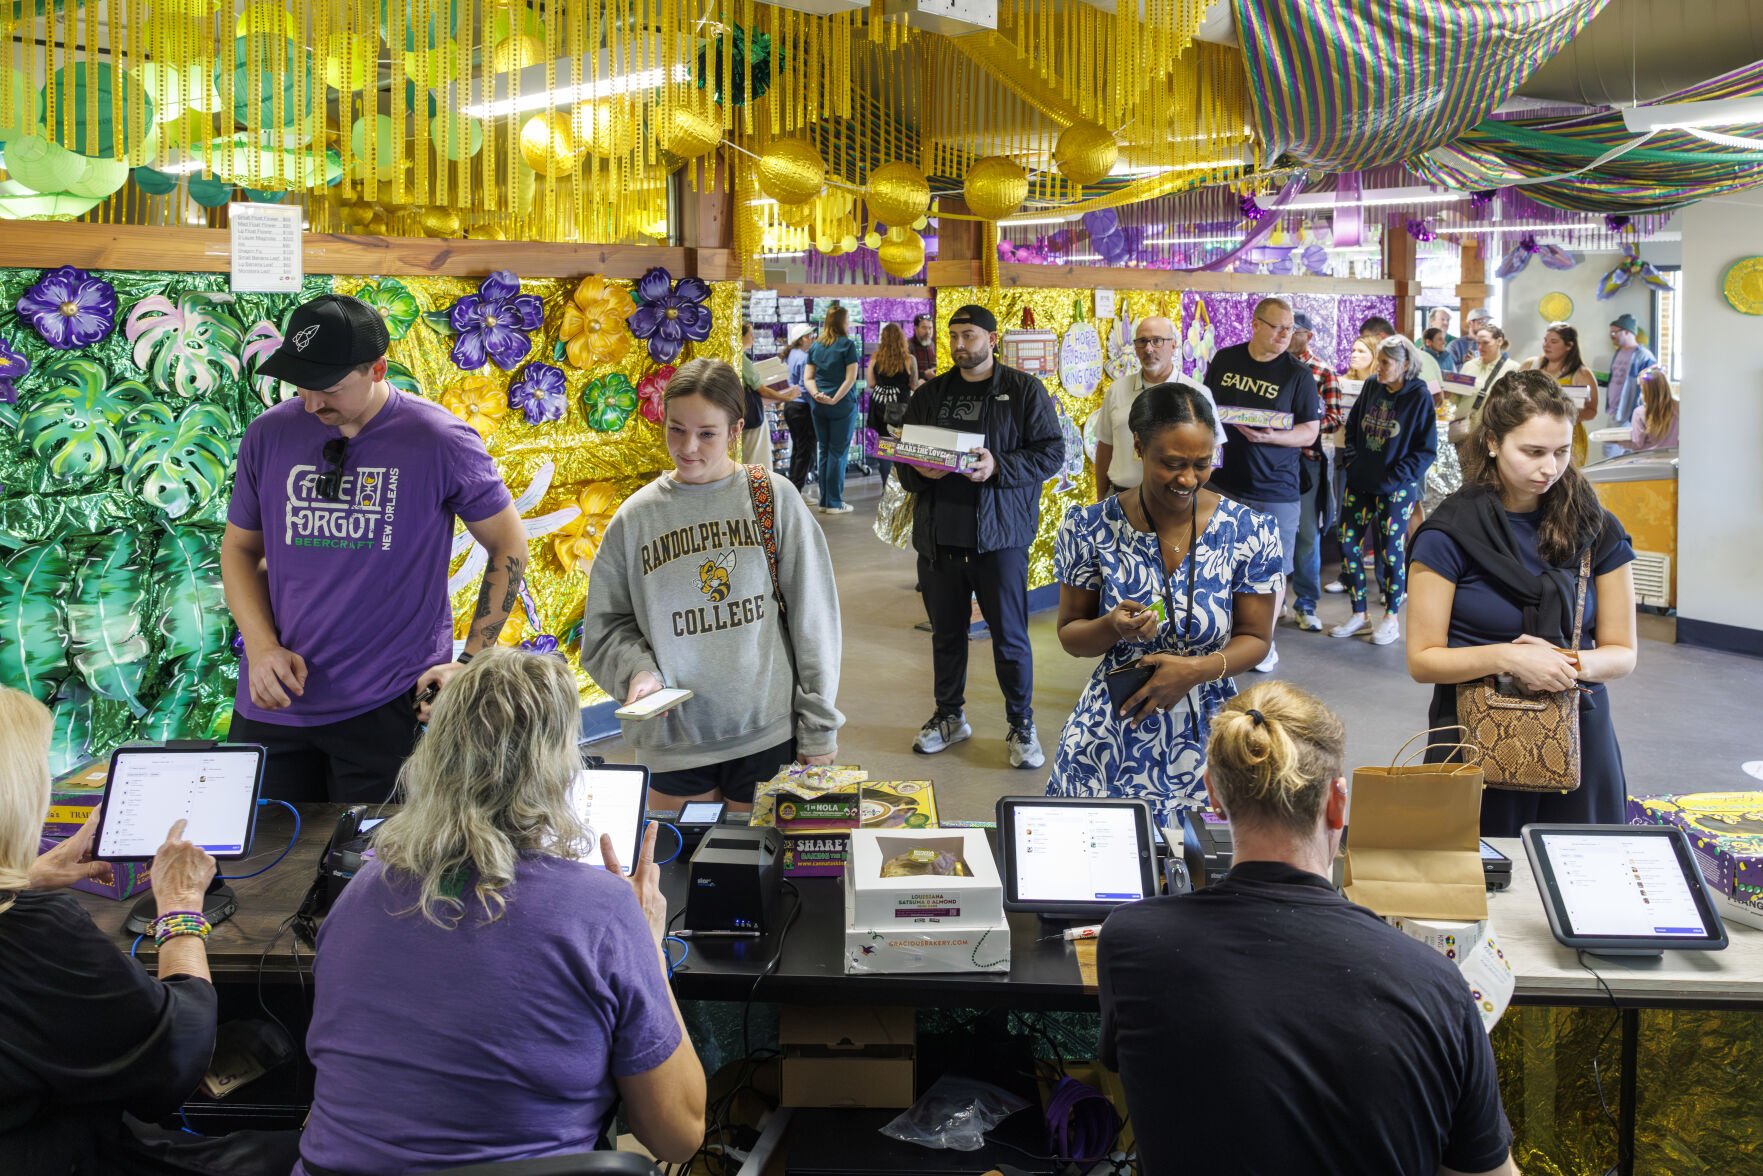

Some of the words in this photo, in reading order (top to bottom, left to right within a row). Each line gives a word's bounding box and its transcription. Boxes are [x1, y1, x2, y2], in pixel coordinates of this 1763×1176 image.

[1066, 334, 1072, 348] I
[1075, 330, 1097, 346] HOPE
[1074, 349, 1100, 365] BROUGHT
[1065, 370, 1083, 386] KING
[1084, 366, 1101, 384] CAKE
[1221, 372, 1280, 399] SAINTS
[286, 464, 354, 508] CAE
[385, 468, 399, 522] ORLEANS
[286, 500, 382, 544] FORGOT
[295, 538, 374, 549] BEERCRAFT
[382, 525, 392, 550] NEW
[672, 594, 764, 637] COLLEGE
[797, 840, 842, 852] SHARE
[888, 940, 968, 948] GRACIOUSBAKERY.COM
